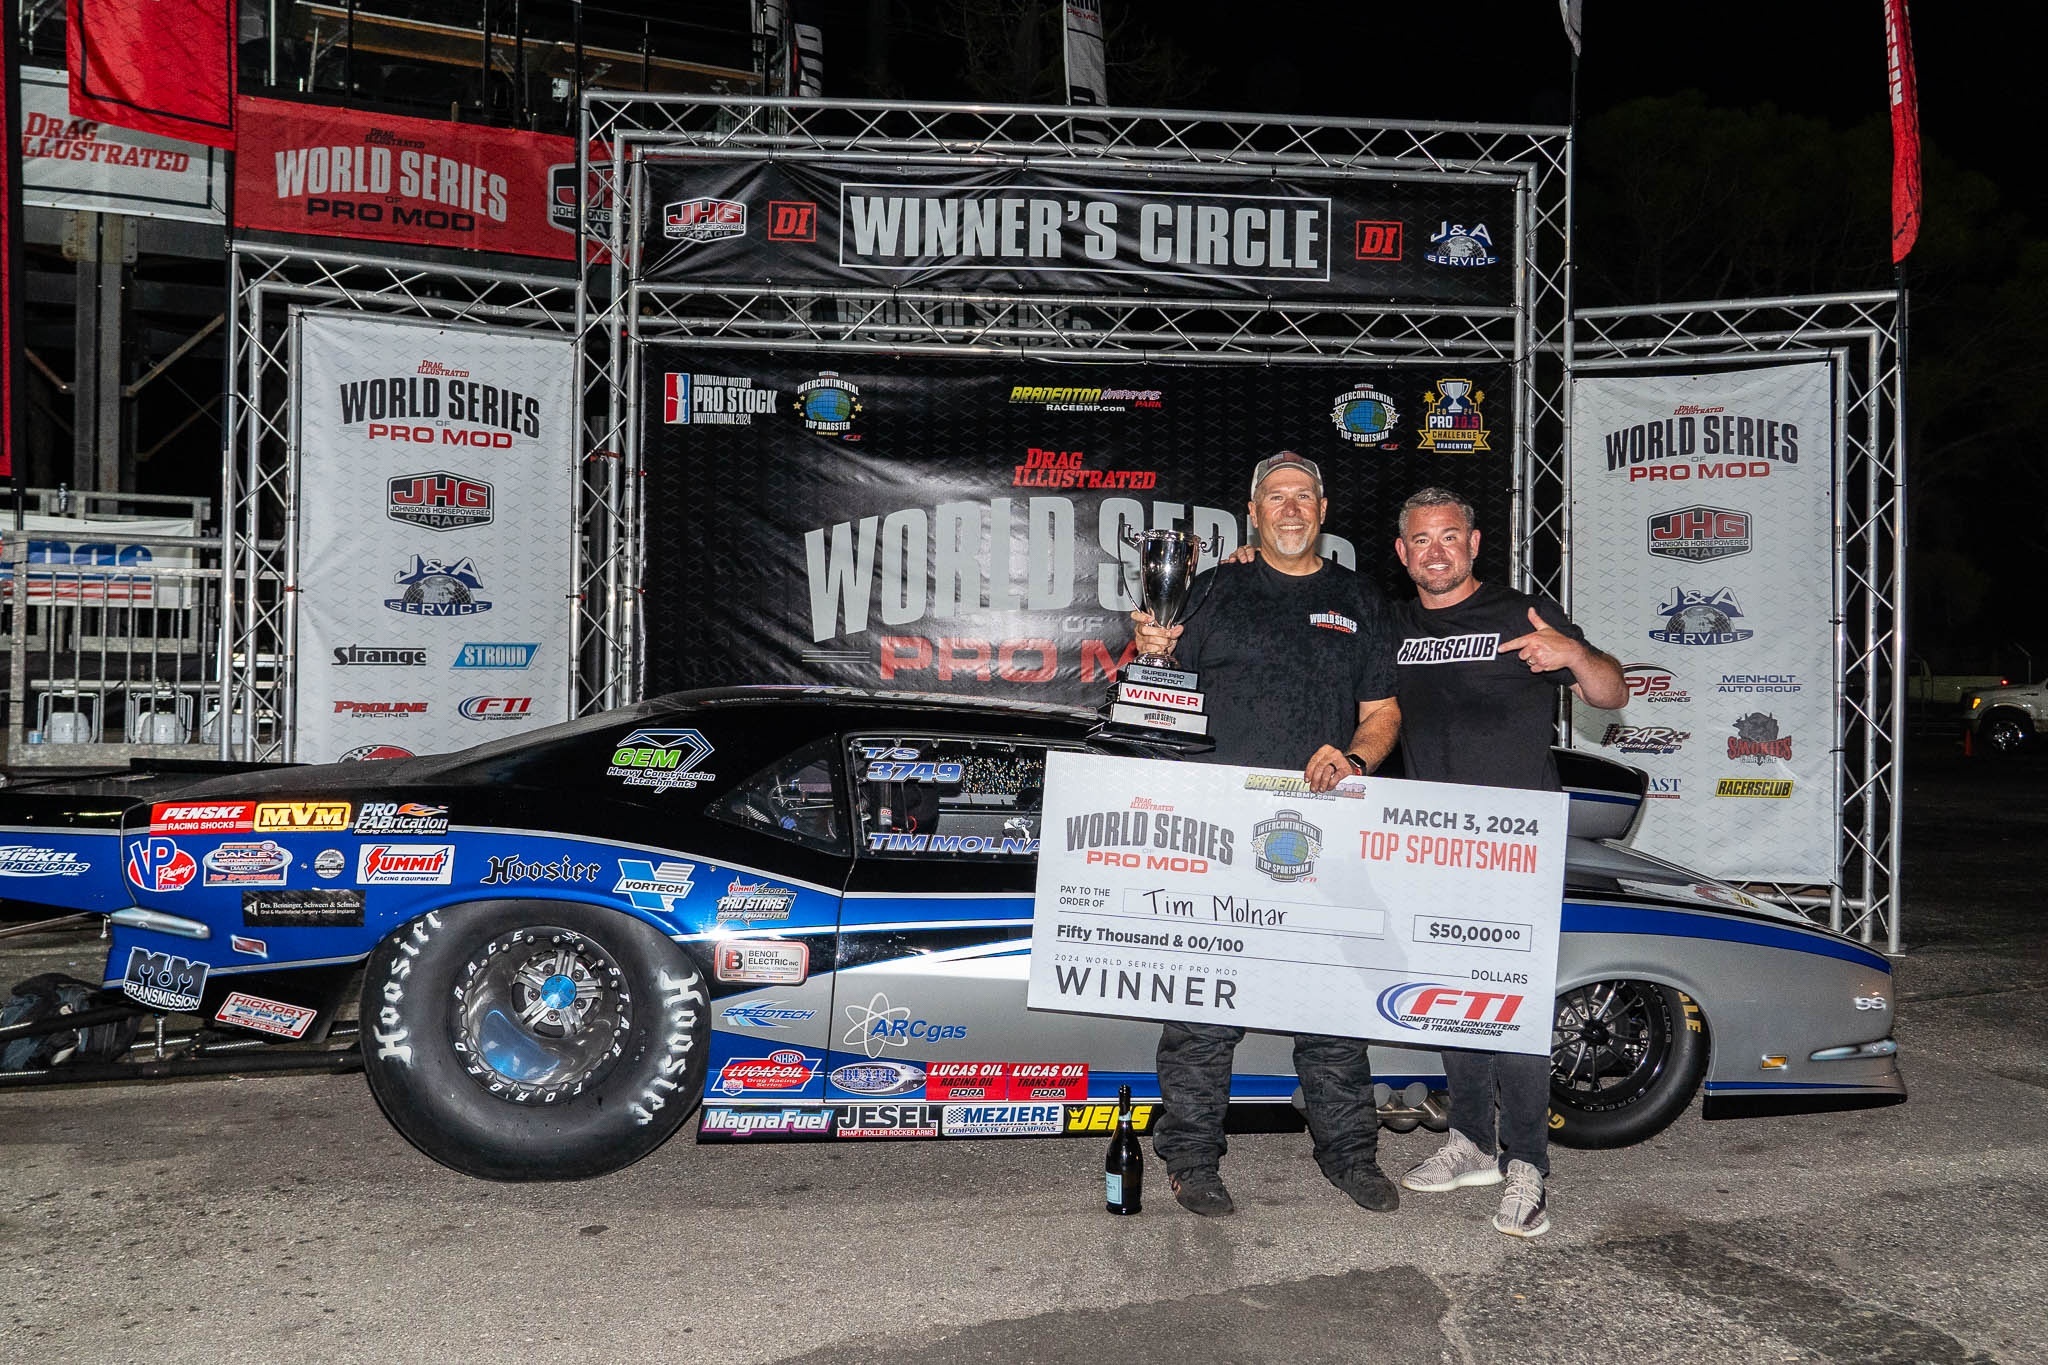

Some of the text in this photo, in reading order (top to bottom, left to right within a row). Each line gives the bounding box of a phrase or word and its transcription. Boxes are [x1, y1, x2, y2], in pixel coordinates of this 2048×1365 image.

[25, 112, 99, 141] DRAG
[275, 145, 391, 198] WORLD
[400, 149, 508, 222] SERIES
[307, 198, 475, 232] PRO MOD
[667, 201, 742, 225] JHG
[773, 207, 811, 235] DI
[850, 196, 1318, 269] WINNER'S CIRCLE
[1361, 227, 1397, 254] DI
[1430, 221, 1493, 246] J&A
[1427, 255, 1496, 267] SERVICE
[417, 366, 470, 378] ILLUSTRATED
[422, 360, 443, 369] DRAG
[694, 374, 752, 388] MOUNTAIN MOTOR
[797, 378, 860, 396] INTERCONTINENTAL
[340, 377, 540, 438] WORLD SERIES
[693, 386, 778, 414] PRO STOCK
[1334, 390, 1395, 407] INTERCONTINENTAL
[1046, 404, 1126, 412] RACEBMP.com
[693, 413, 735, 425] INVITATIONAL
[1429, 416, 1479, 428] PRO 10.5
[369, 423, 513, 449] PRO MOD
[1432, 431, 1478, 439] CHALLENGE
[1605, 415, 1798, 471] WORLD SERIES
[1025, 448, 1084, 470] DRAG
[1012, 466, 1157, 490] ILLUSTRATED
[1629, 461, 1770, 482] PRO MOD
[392, 477, 488, 508] JHG
[390, 505, 491, 516] JOHNSON'S HORSEPOWERED
[405, 513, 475, 526] GARAGE
[1653, 512, 1746, 540] JHG
[1651, 539, 1749, 548] JOHNSON'S HORSEPOWERED
[394, 554, 484, 589] J&A
[805, 496, 1075, 643] WORLD
[389, 601, 488, 616] SERVICE
[1657, 586, 1745, 618] J&A
[1309, 613, 1358, 633] WORLD SERIES
[1653, 631, 1748, 645] SERVICE
[464, 646, 527, 666] STROUD
[1399, 636, 1495, 662] RACERSCLUB
[880, 636, 1058, 682] PRO
[1141, 675, 1184, 685] SHOOTOUT
[1142, 669, 1168, 678] SUPER
[1721, 674, 1796, 683] MENHOLT
[1126, 688, 1199, 706] WINNER
[1718, 685, 1801, 693] AUTO GROUP
[476, 697, 532, 713] FTI
[862, 746, 921, 760] T/S
[1727, 736, 1793, 761] SMOKIES
[612, 747, 682, 769] GEM
[607, 767, 716, 781] Heavy Construction
[867, 761, 963, 783] 3749
[623, 776, 697, 788] Attachments
[1717, 780, 1792, 796] RACERSCLUB
[160, 806, 246, 820] PENSKE
[260, 803, 345, 827] MVM
[360, 803, 398, 816] PRO
[167, 821, 235, 830] RACING SHOCKS
[354, 815, 449, 829] FABrication
[1257, 821, 1318, 840] INTERCONTINENTAL
[1383, 807, 1539, 836] MARCH 3, 2024
[868, 832, 929, 851] TIM
[1066, 811, 1235, 866] WORLD SERIES
[1360, 830, 1538, 874] TOP SPORTSMAN
[1, 861, 91, 872] RACE CARS
[130, 837, 177, 891] VP
[481, 854, 603, 885] Hoosier
[1086, 850, 1209, 874] PRO MOD
[1260, 861, 1309, 875] TOP SPORTSMAN
[159, 861, 195, 882] Racing
[623, 880, 685, 894] VORTECH
[1060, 885, 1111, 897] PAY TO THE
[745, 896, 788, 911] STARS
[1059, 897, 1105, 908] ORDER OF
[1142, 889, 1288, 927] Tim Molnar
[1057, 924, 1244, 953] Fifty Thousand & 00/100
[1054, 953, 1238, 976] 2024 WORLD SERIES OF PRO MOD
[1471, 969, 1528, 985] DOLLARS
[125, 982, 200, 1009] TRANSMISSION
[1055, 965, 1237, 1010] WINNER
[234, 996, 310, 1018] HICKORY
[1410, 988, 1524, 1023] FTI
[1855, 996, 1887, 1011] SS
[721, 1007, 817, 1021] SPEEDTECH
[1400, 1014, 1521, 1032] COMPETITION CONVERTERS
[1430, 1024, 1503, 1037] TRANSMISSIONS
[729, 1065, 804, 1078] LUCAS OIL
[930, 1064, 1003, 1077] LUCAS OIL
[1012, 1065, 1084, 1077] LUCAS OIL
[940, 1077, 994, 1087] RACING OIL
[1017, 1077, 1081, 1087] TRANS DIFF
[704, 1110, 831, 1133] MagnaFuel
[838, 1106, 936, 1129] JESEL
[964, 1106, 1060, 1123] MEZIERE
